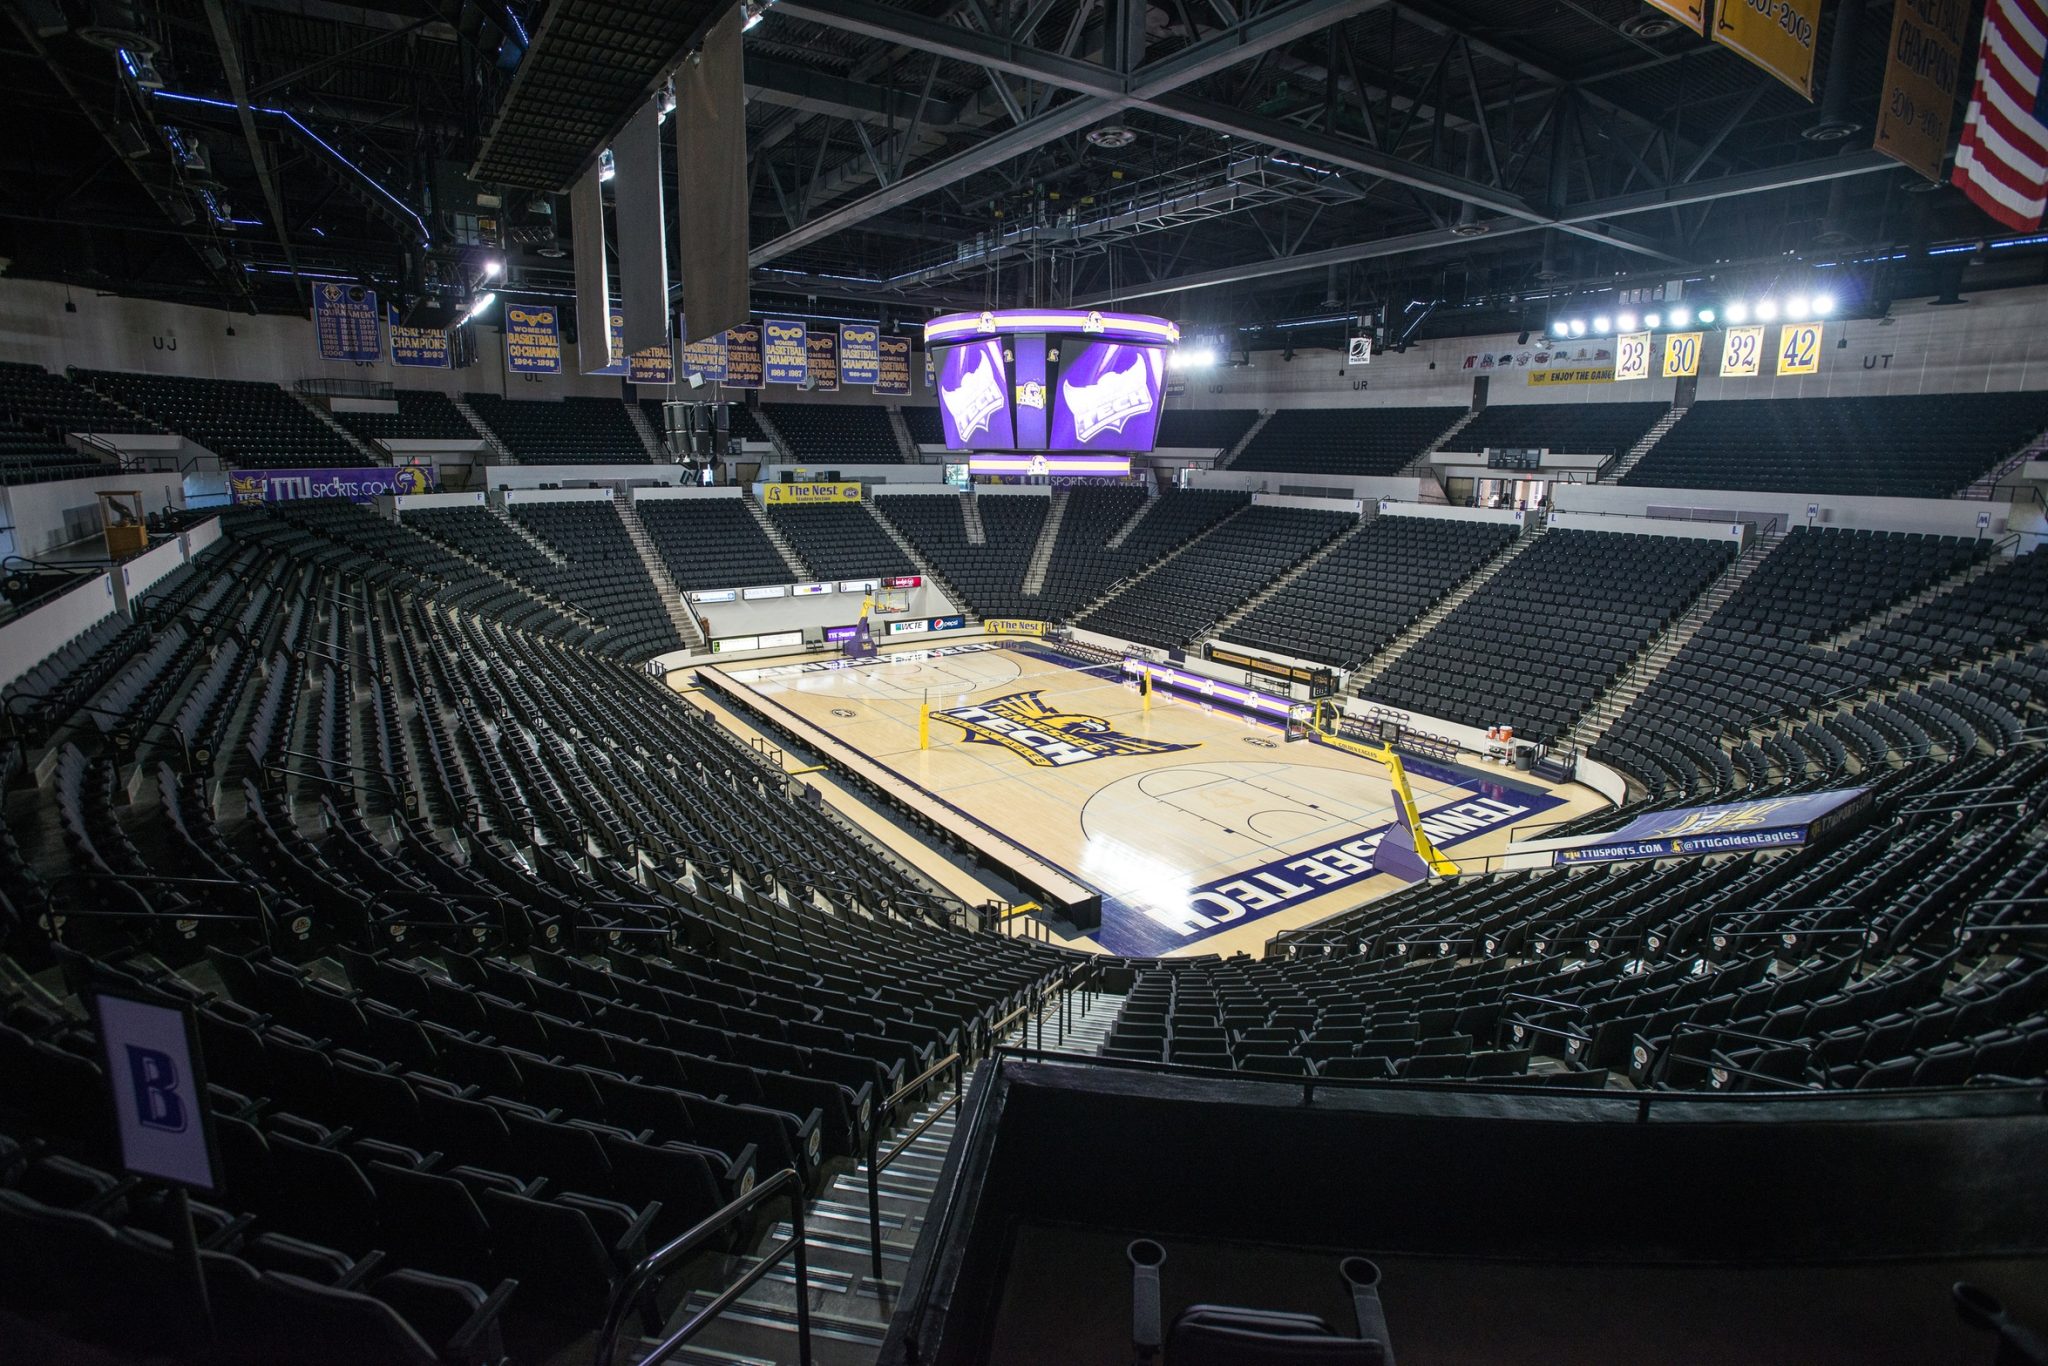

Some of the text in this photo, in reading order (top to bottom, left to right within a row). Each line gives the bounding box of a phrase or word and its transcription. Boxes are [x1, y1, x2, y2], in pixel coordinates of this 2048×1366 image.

[319, 308, 375, 318] TOURNAMENT
[153, 336, 176, 351] UJ
[391, 337, 447, 350] CHAMPIONS
[508, 333, 558, 346] BASKETBALL
[766, 345, 805, 357] BASKETBALL
[842, 348, 878, 360] BASKETBALL
[1728, 335, 1755, 367] 32
[1783, 328, 1816, 367] 42
[766, 355, 806, 365] CHAMPIONS
[1622, 341, 1644, 372] 23
[1669, 338, 1695, 373] 30
[1863, 354, 1893, 369] UT
[842, 360, 878, 369] CHAMPIONS
[1551, 371, 1574, 381] ENJOY
[1576, 371, 1589, 380] THE
[1353, 381, 1368, 391] UR
[788, 485, 838, 496] The Nest
[1515, 511, 1521, 520] K
[1808, 506, 1817, 514] M
[1979, 515, 1988, 524] M
[1000, 621, 1039, 631] The Nest
[943, 706, 1098, 765] TECH
[987, 706, 1110, 753] TENNESSEE
[1684, 831, 1799, 851] @TTUGoldenEagles
[1581, 843, 1663, 858] TTUSPORTS.COM
[125, 1043, 188, 1133] B
